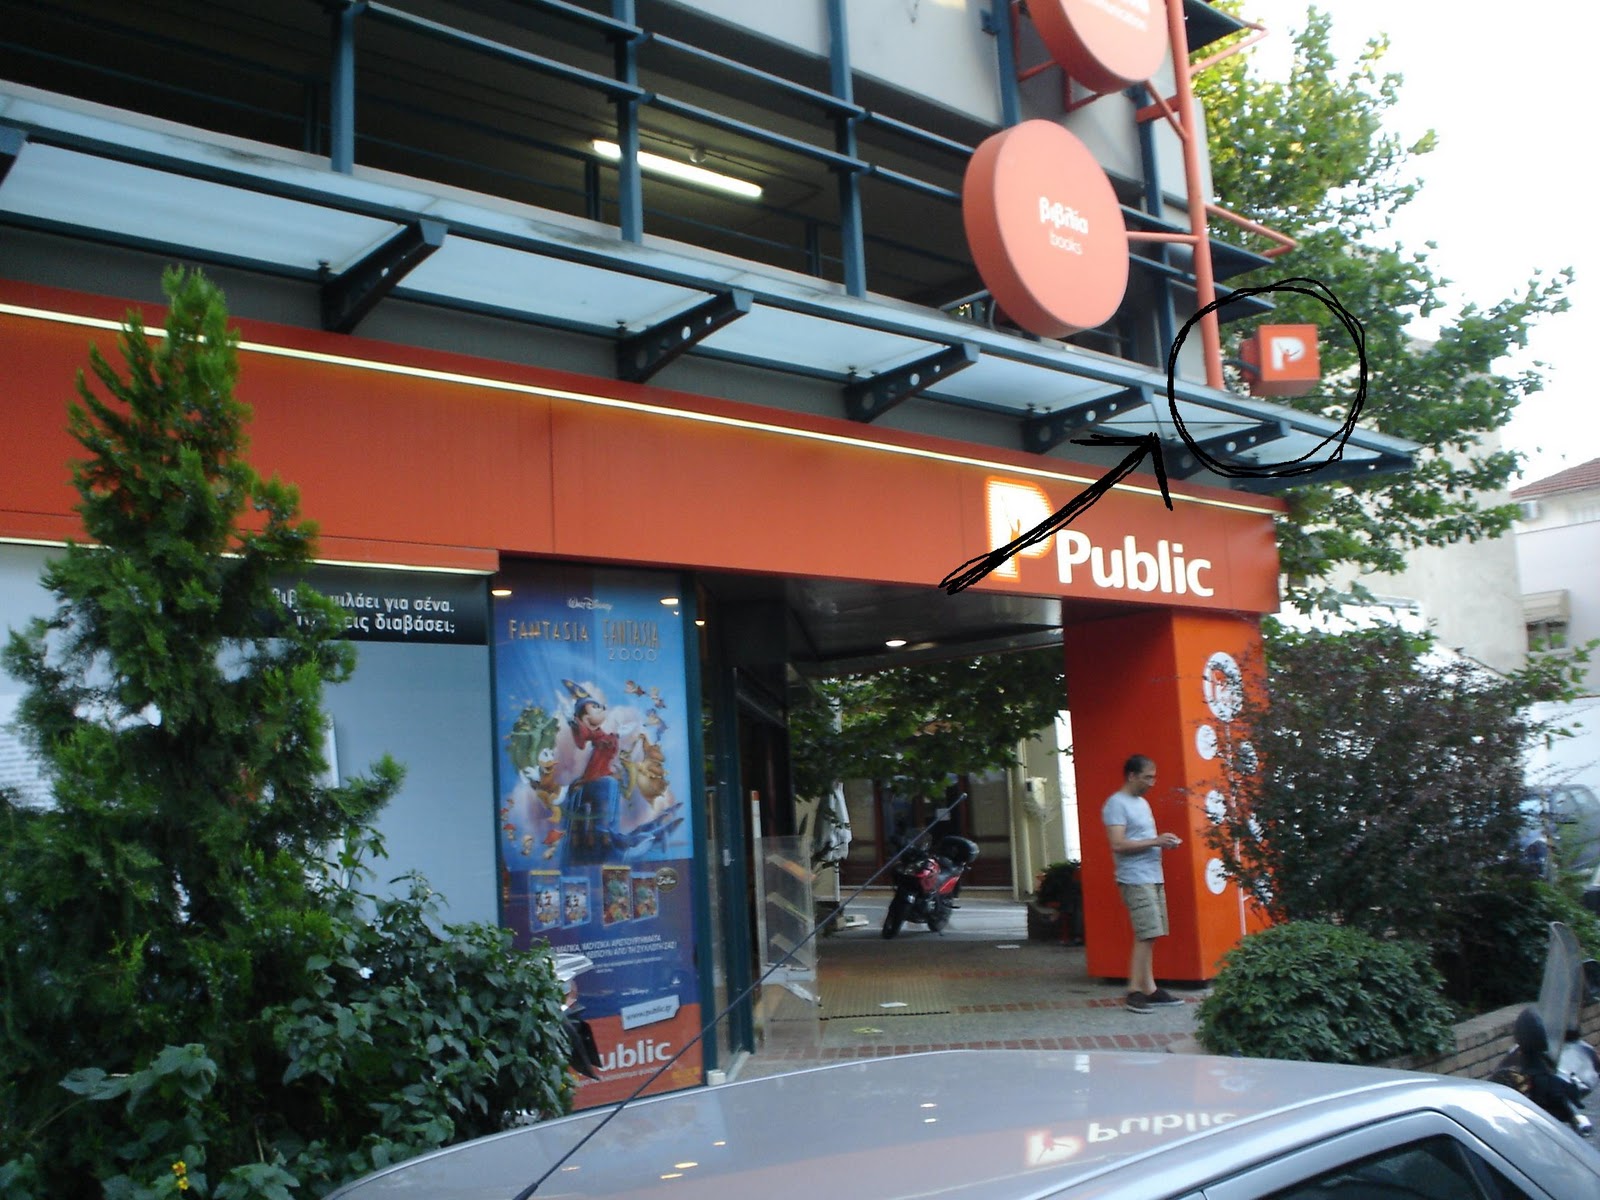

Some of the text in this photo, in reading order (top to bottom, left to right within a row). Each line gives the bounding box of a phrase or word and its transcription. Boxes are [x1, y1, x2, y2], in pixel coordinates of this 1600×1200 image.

[1048, 230, 1084, 256] books
[1055, 528, 1215, 598] Public
[383, 597, 409, 613] για
[413, 593, 455, 613] σένα.
[508, 618, 590, 642] FANTASIA
[603, 619, 660, 648] FANTASIA
[608, 648, 658, 662] 2000
[600, 1038, 673, 1072] ublic
